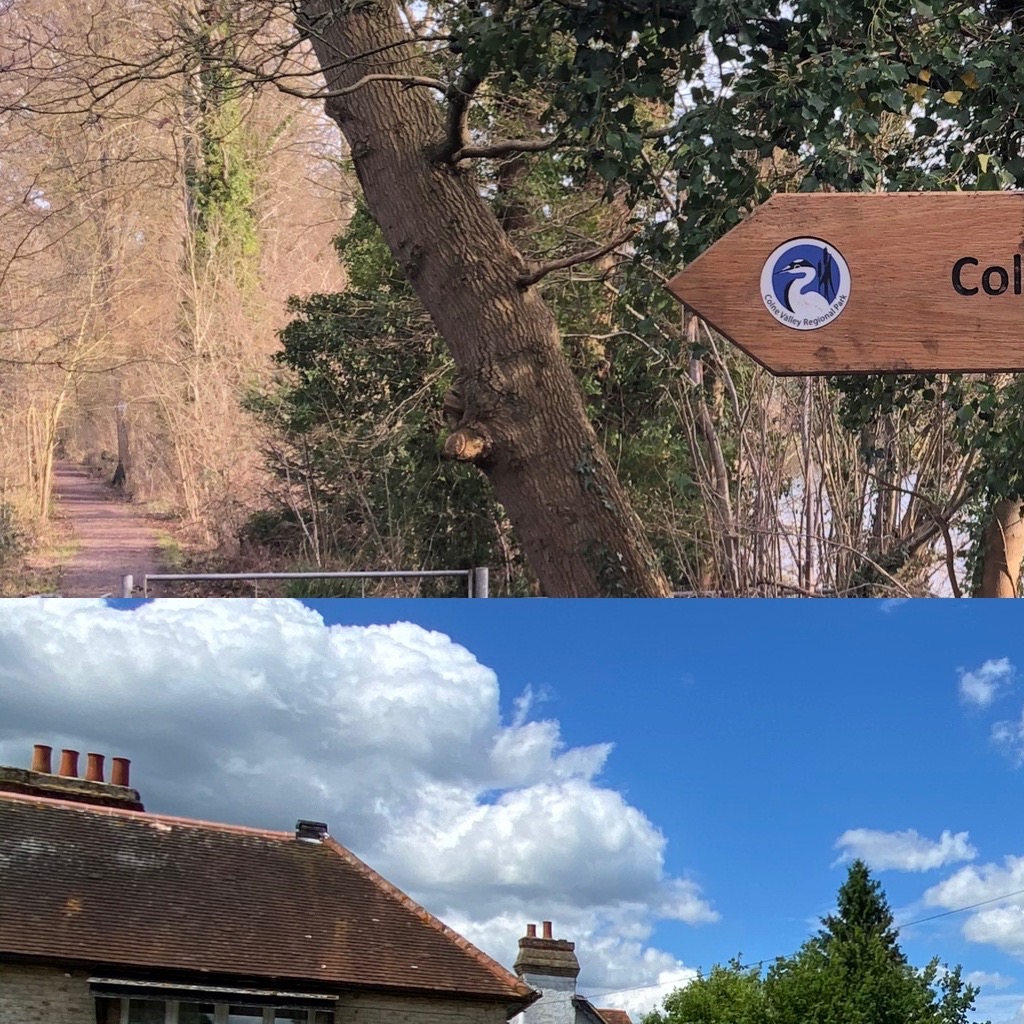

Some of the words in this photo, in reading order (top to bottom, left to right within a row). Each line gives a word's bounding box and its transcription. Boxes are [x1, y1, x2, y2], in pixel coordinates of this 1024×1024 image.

[764, 293, 780, 315] Colne
[780, 311, 802, 327] Valley
[803, 307, 836, 326] Regional
[834, 294, 848, 311] Park
